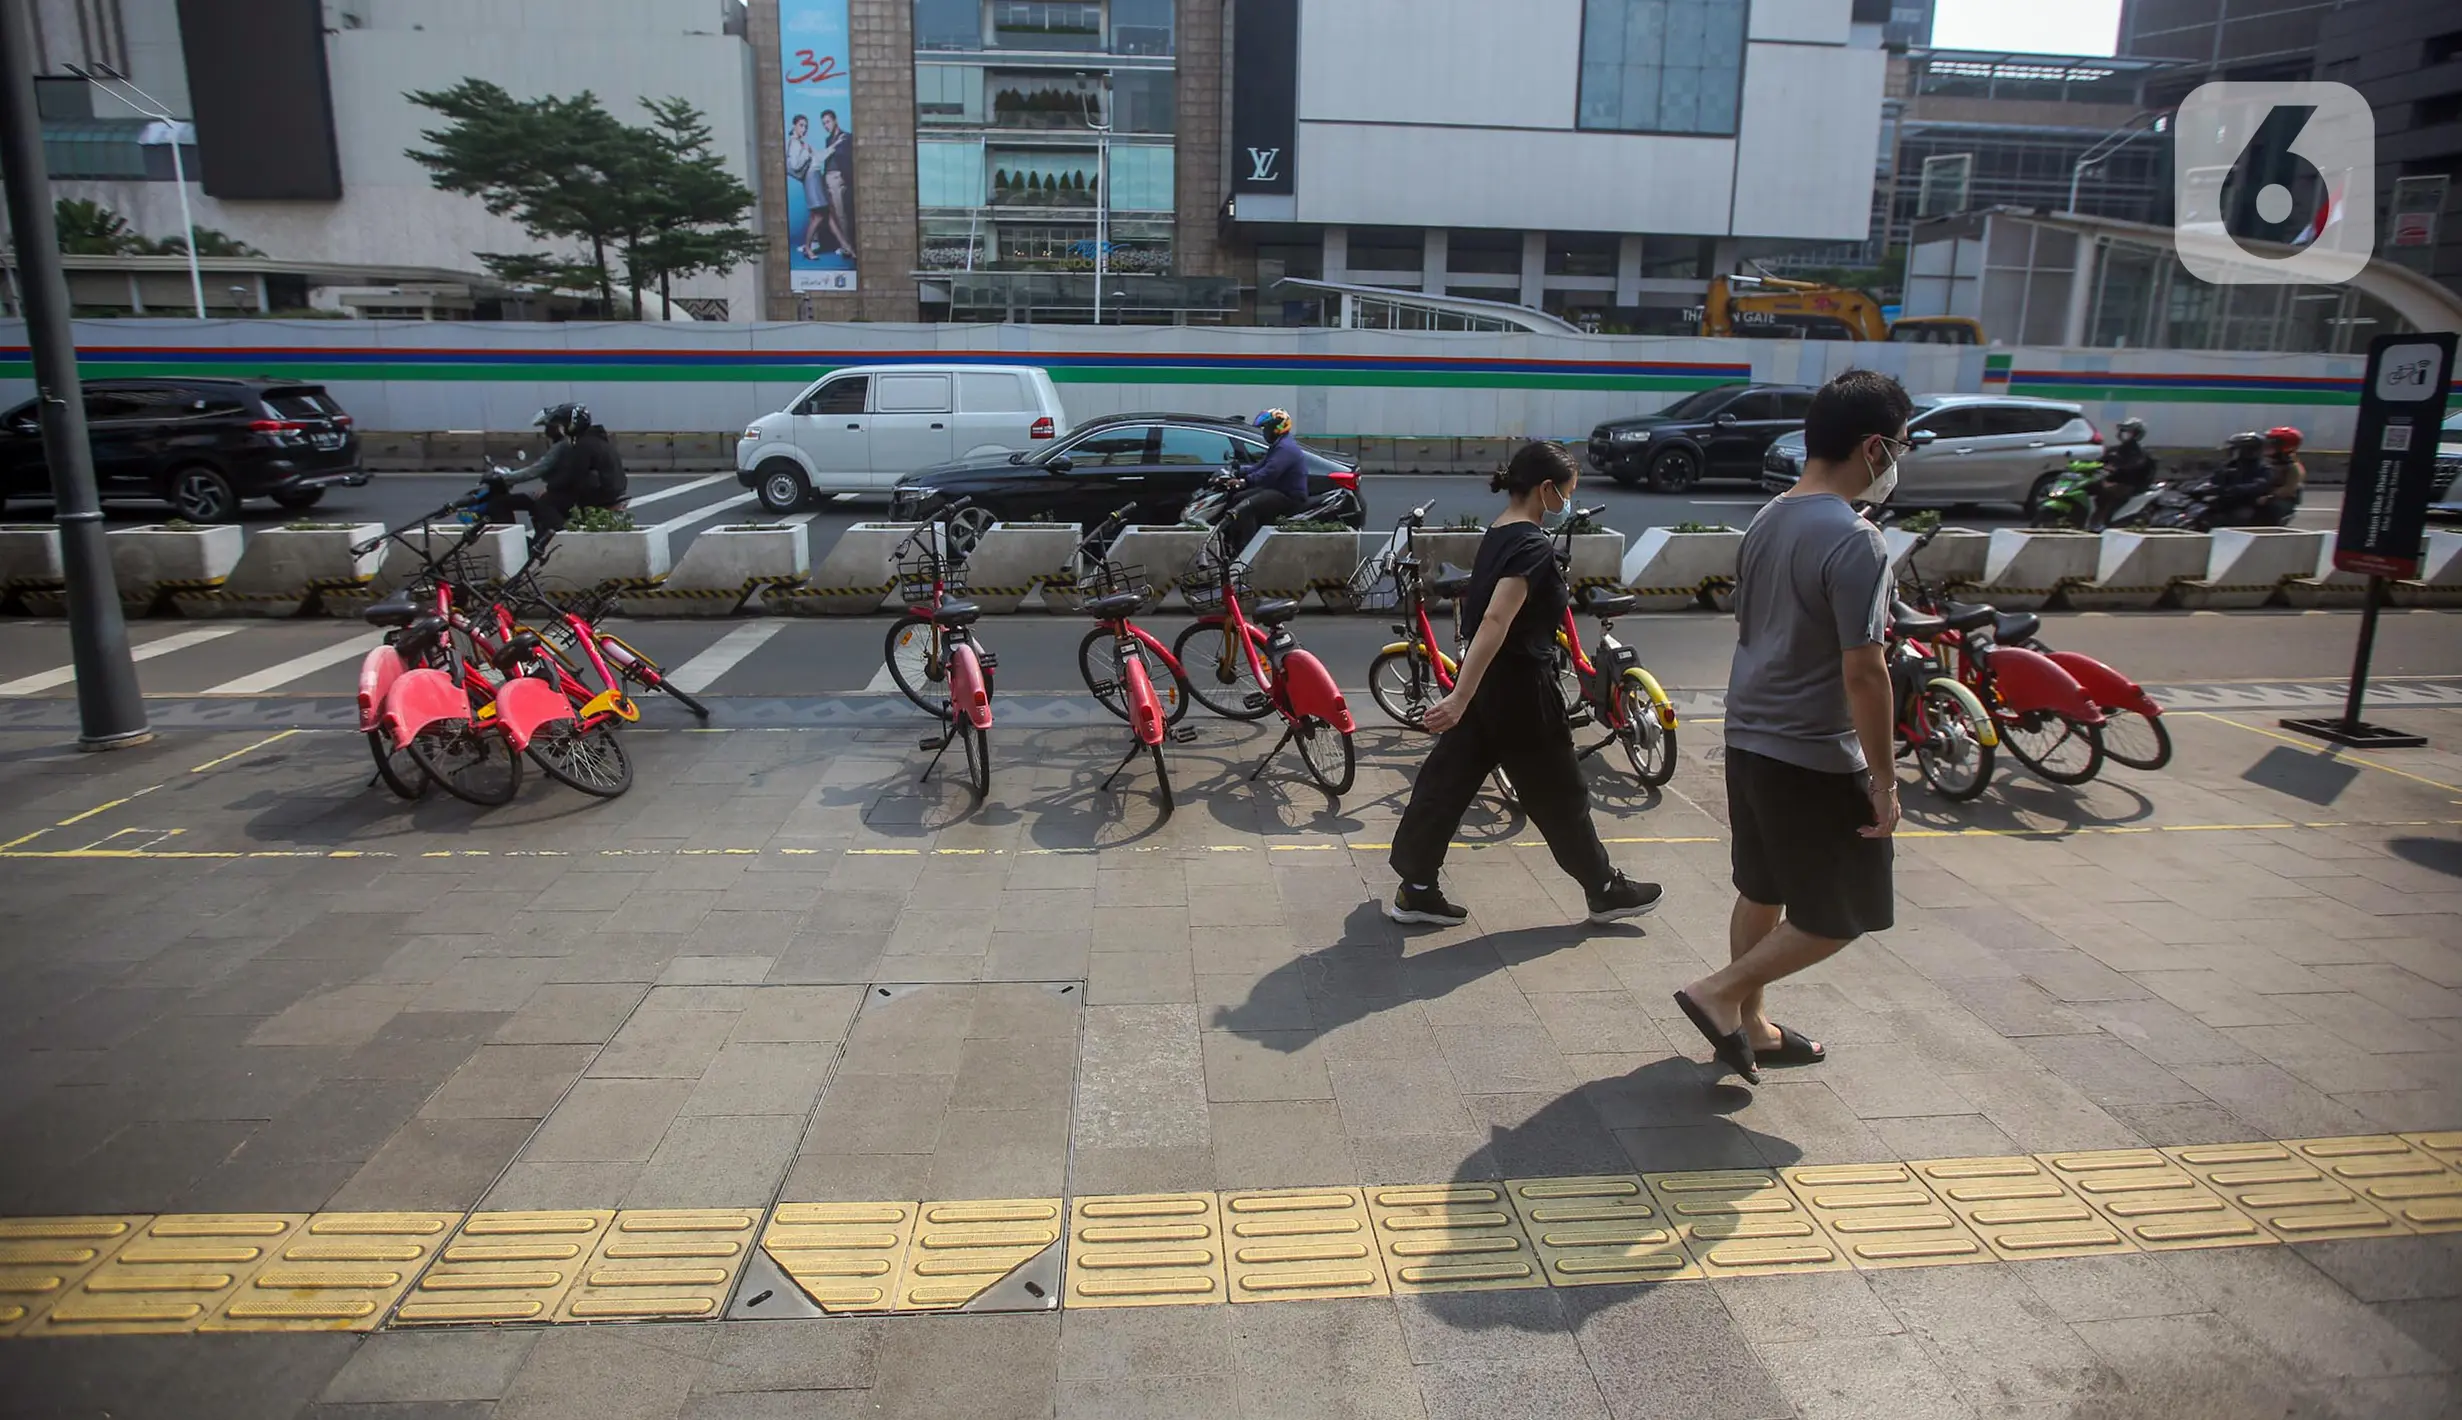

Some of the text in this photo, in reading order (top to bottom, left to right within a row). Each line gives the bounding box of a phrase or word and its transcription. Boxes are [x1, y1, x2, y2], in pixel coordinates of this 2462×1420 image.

[785, 49, 848, 84] 32
[1743, 311, 1776, 324] GATE
[2374, 459, 2393, 494] Sharing
[2368, 494, 2383, 514] Bike
